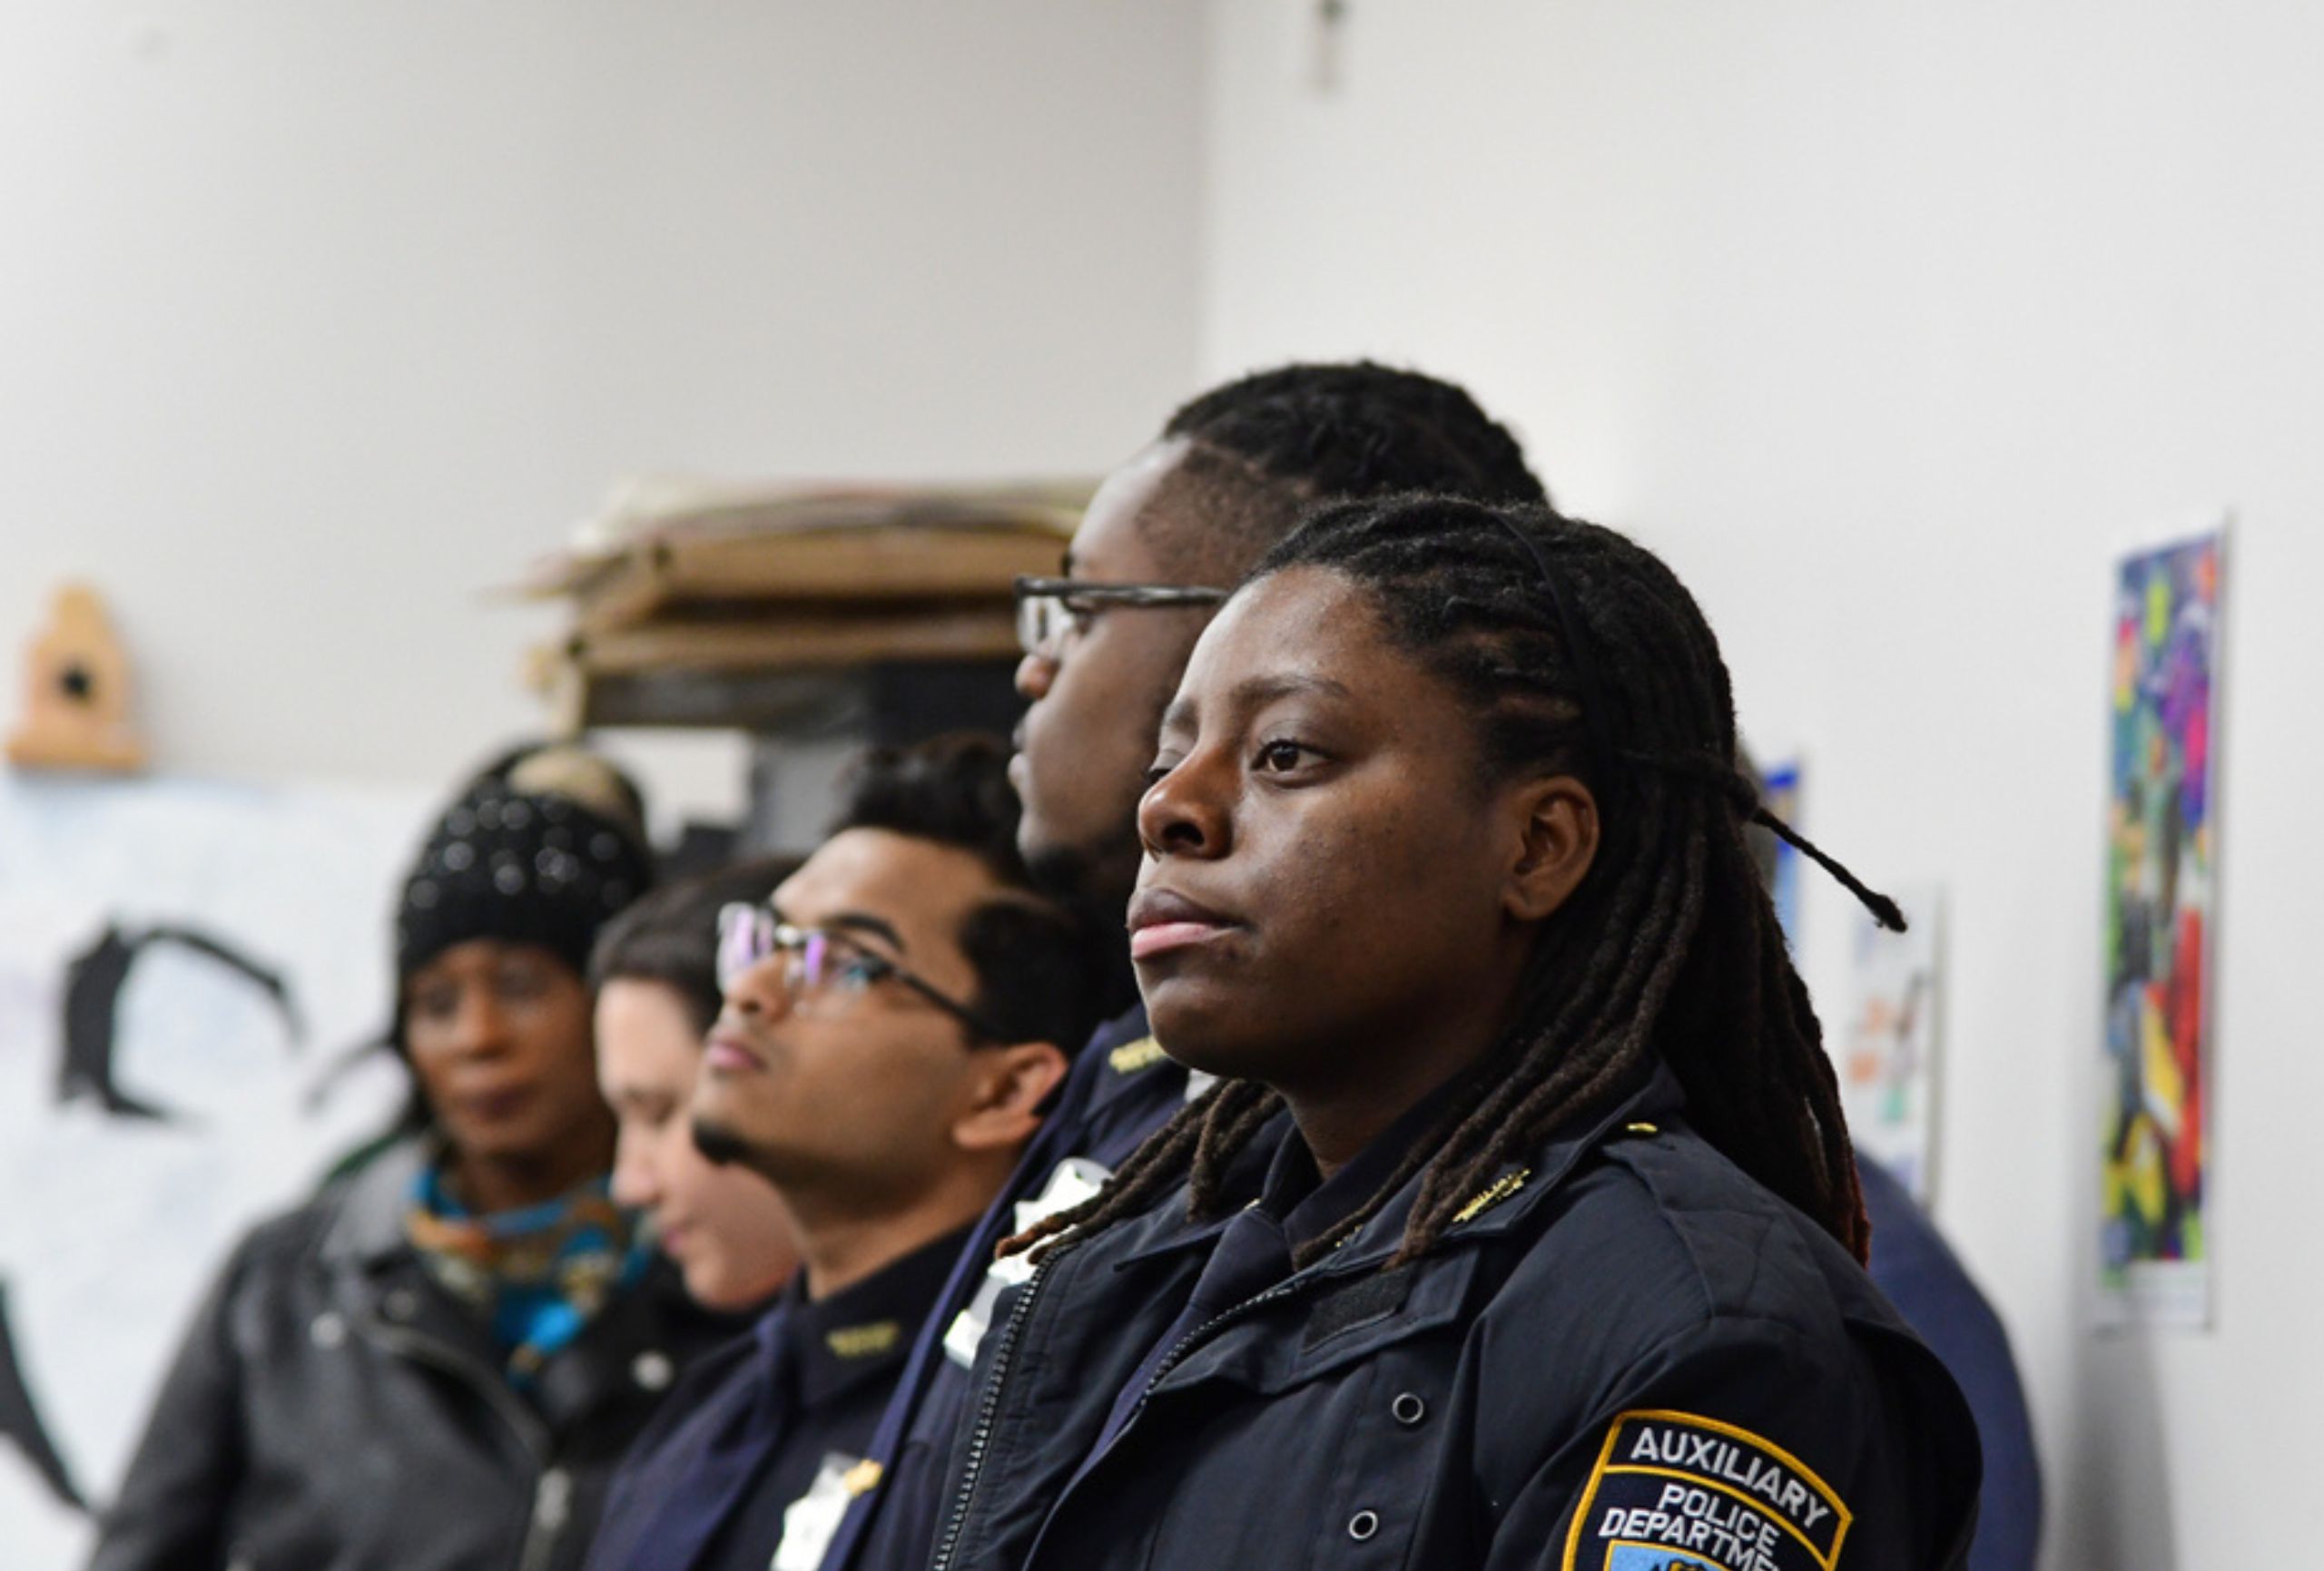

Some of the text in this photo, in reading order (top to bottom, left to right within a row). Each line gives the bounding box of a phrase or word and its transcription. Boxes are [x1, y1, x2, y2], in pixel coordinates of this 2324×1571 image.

[1630, 1427, 1830, 1529] AUXILIARY
[1599, 1507, 1780, 1571] DEPARTME
[1658, 1482, 1780, 1556] POLICE
